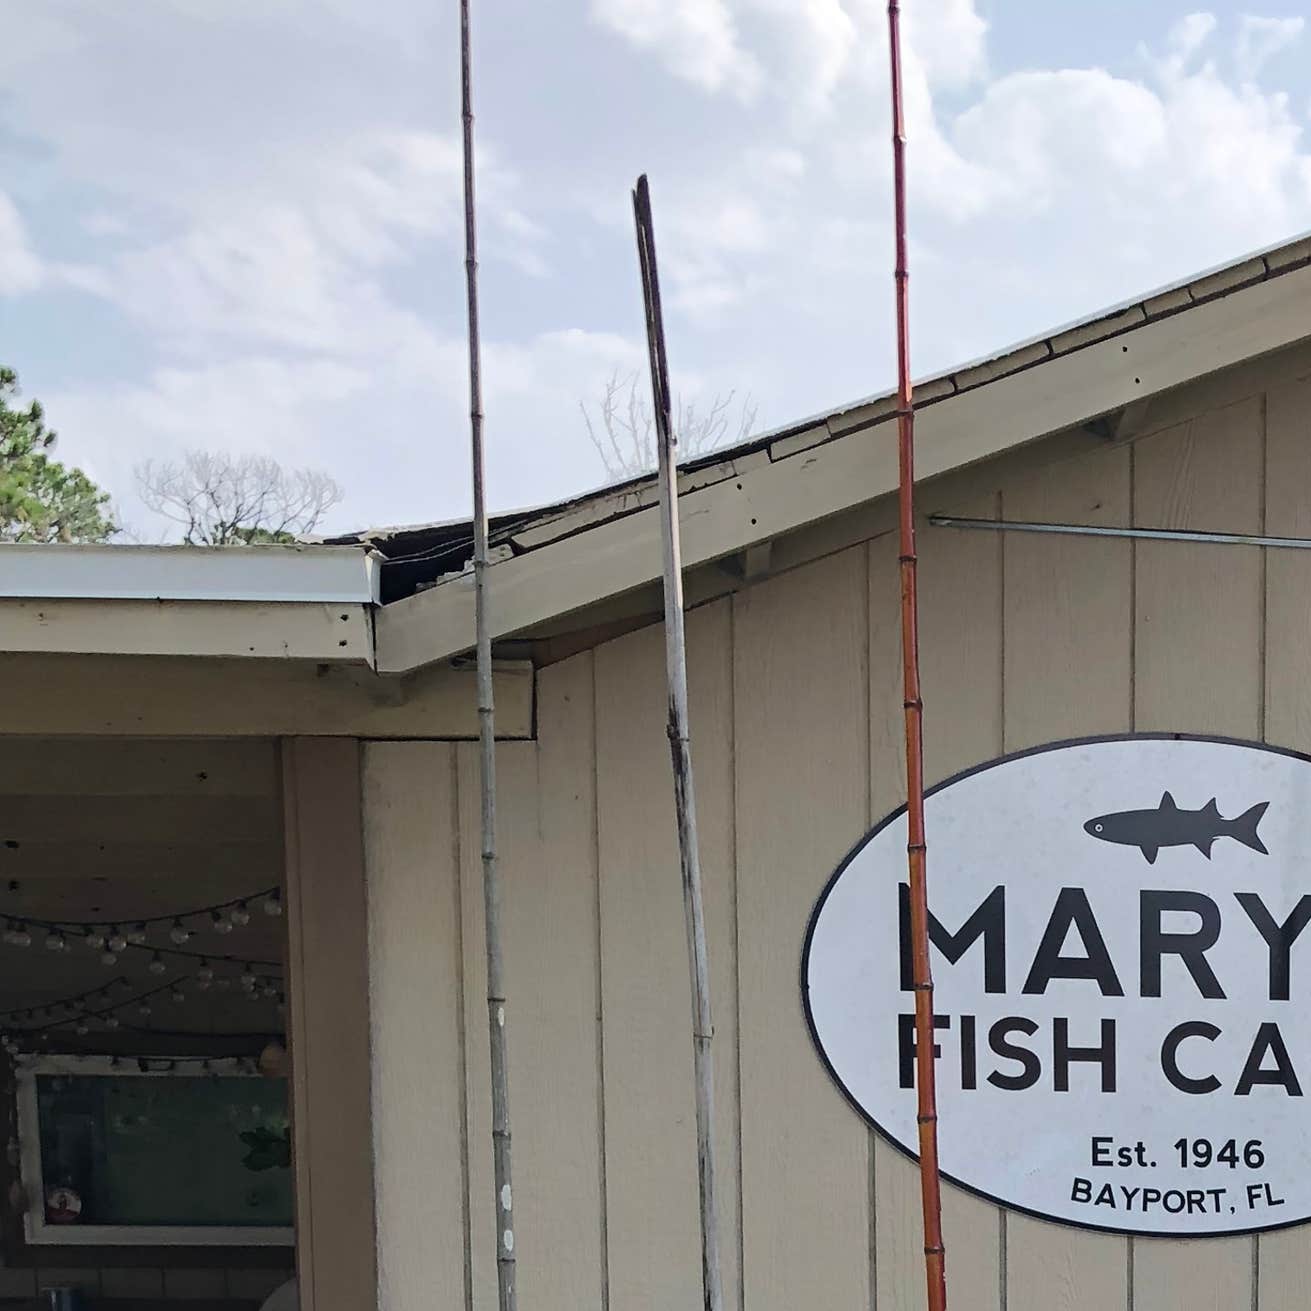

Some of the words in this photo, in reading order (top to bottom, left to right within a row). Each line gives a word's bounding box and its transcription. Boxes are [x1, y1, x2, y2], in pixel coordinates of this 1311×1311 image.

[898, 1013, 1117, 1093] FISH
[1090, 1136, 1158, 1169] Est.
[1174, 1138, 1266, 1170] 1946
[1070, 1177, 1236, 1216] BAYPORT,
[1247, 1183, 1286, 1209] FL
